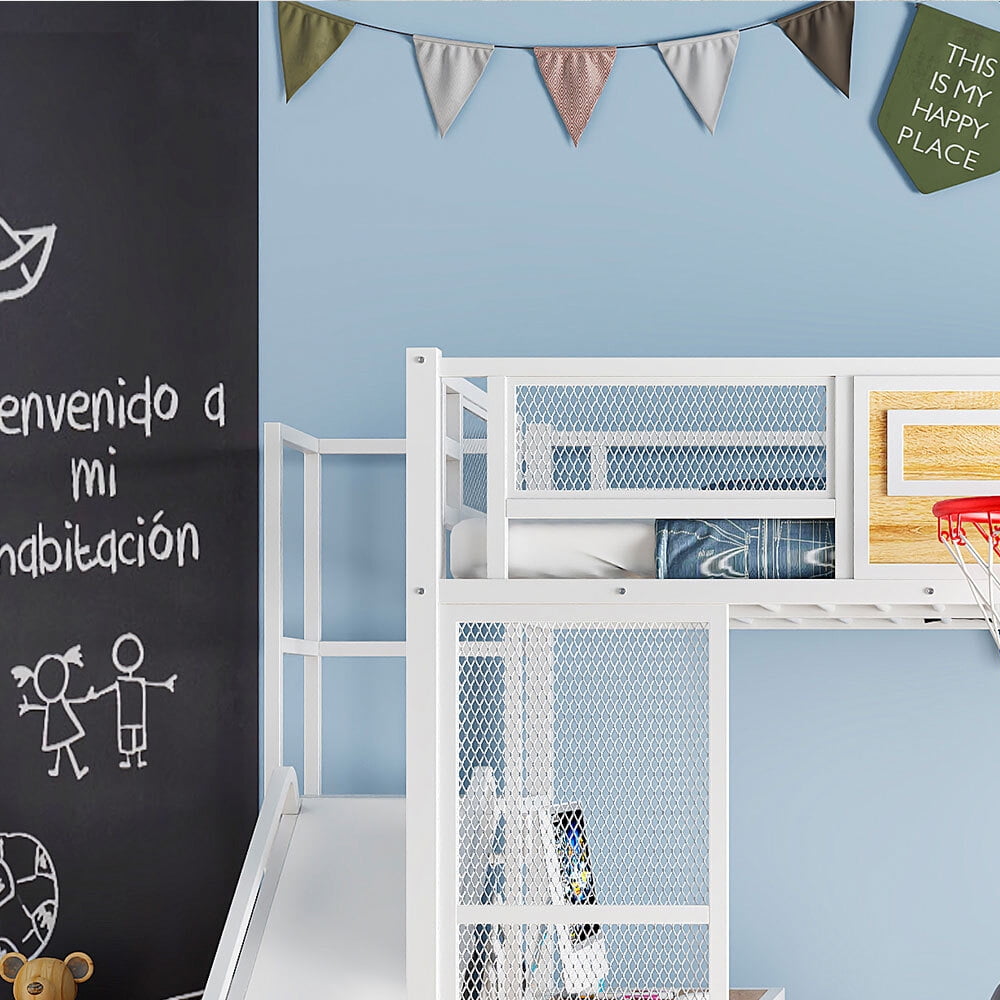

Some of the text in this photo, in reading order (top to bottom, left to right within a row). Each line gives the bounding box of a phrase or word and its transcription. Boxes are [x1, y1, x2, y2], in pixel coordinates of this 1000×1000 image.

[947, 42, 998, 78] THIS
[929, 71, 993, 108] IS MY
[911, 97, 990, 139] HAPPY
[897, 125, 980, 171] PLACE
[0, 375, 226, 438] envenido a
[71, 445, 117, 502] mi
